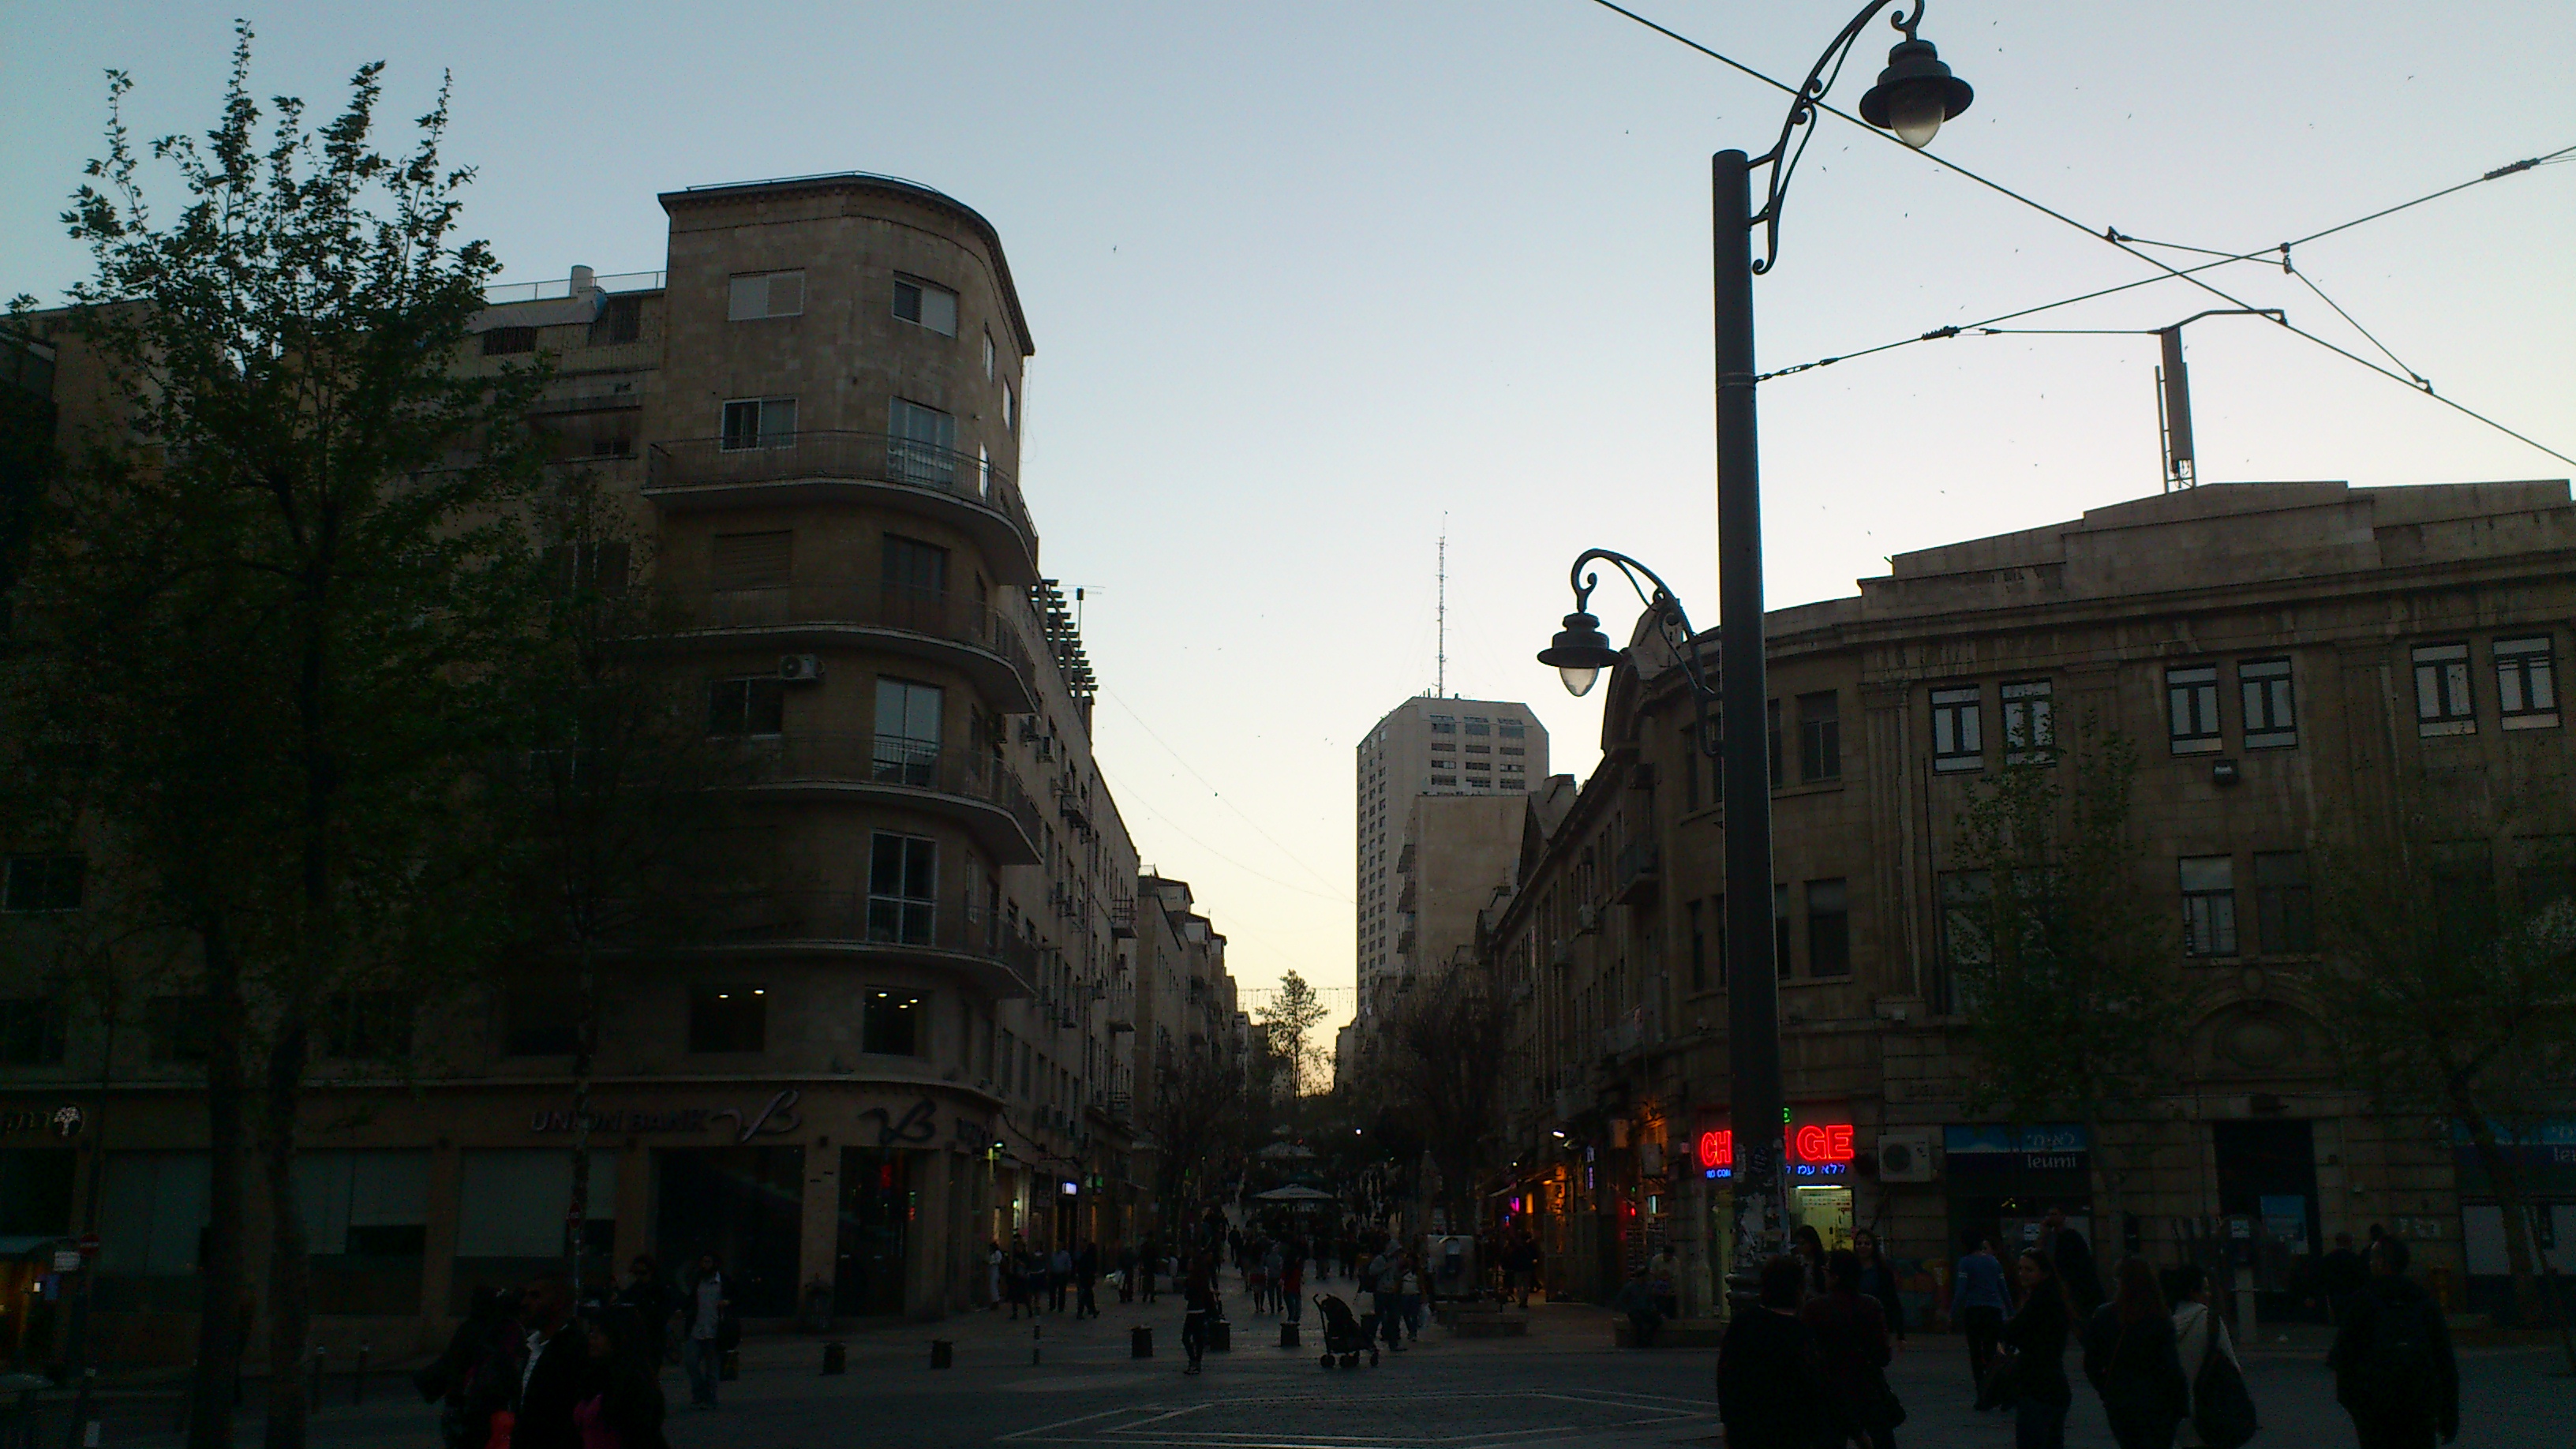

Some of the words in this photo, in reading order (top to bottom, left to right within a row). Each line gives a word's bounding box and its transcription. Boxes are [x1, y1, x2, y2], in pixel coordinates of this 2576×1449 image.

[529, 1110, 622, 1133] UNION
[628, 1109, 708, 1133] BANK
[1700, 1125, 1855, 1166] CHGE
[2027, 1153, 2076, 1169] leumi
